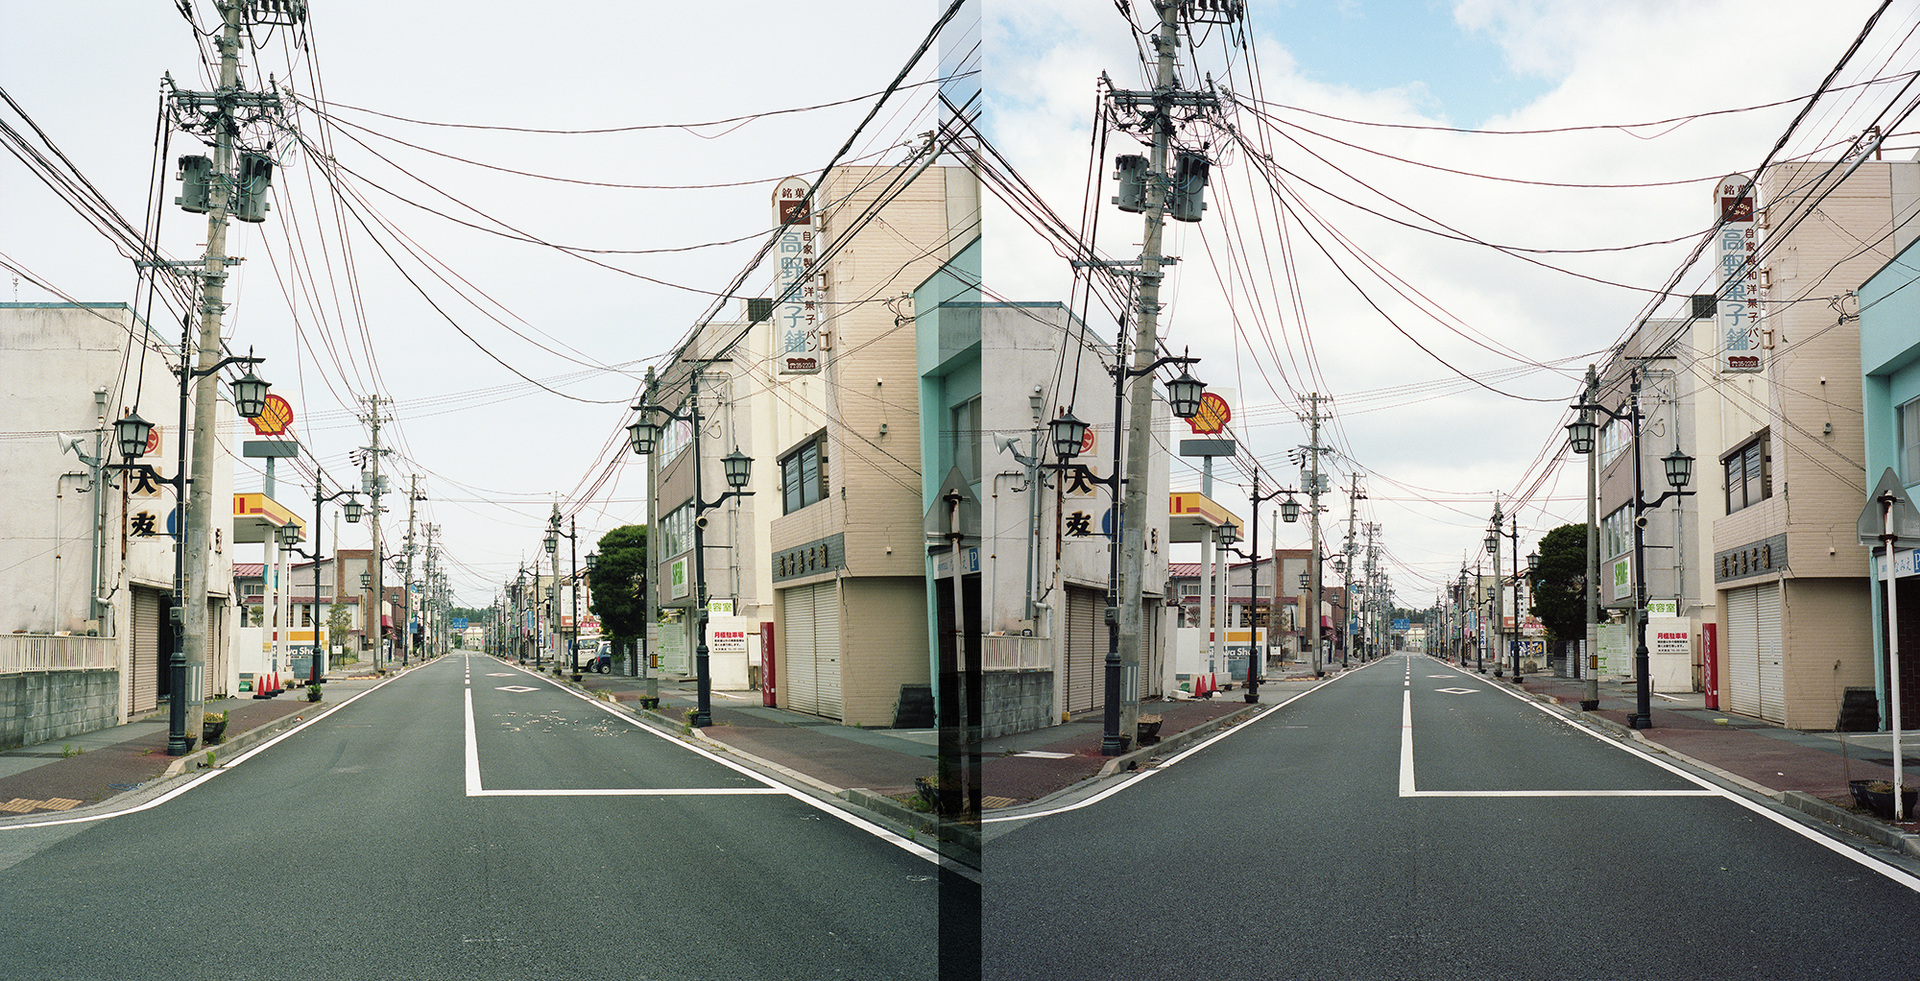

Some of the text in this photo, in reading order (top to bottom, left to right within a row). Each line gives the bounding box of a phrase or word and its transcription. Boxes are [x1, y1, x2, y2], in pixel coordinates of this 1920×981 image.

[782, 187, 806, 199] 銘菓
[970, 551, 977, 568] P
[1914, 553, 1920, 570] P
[1646, 603, 1676, 613] 美容室
